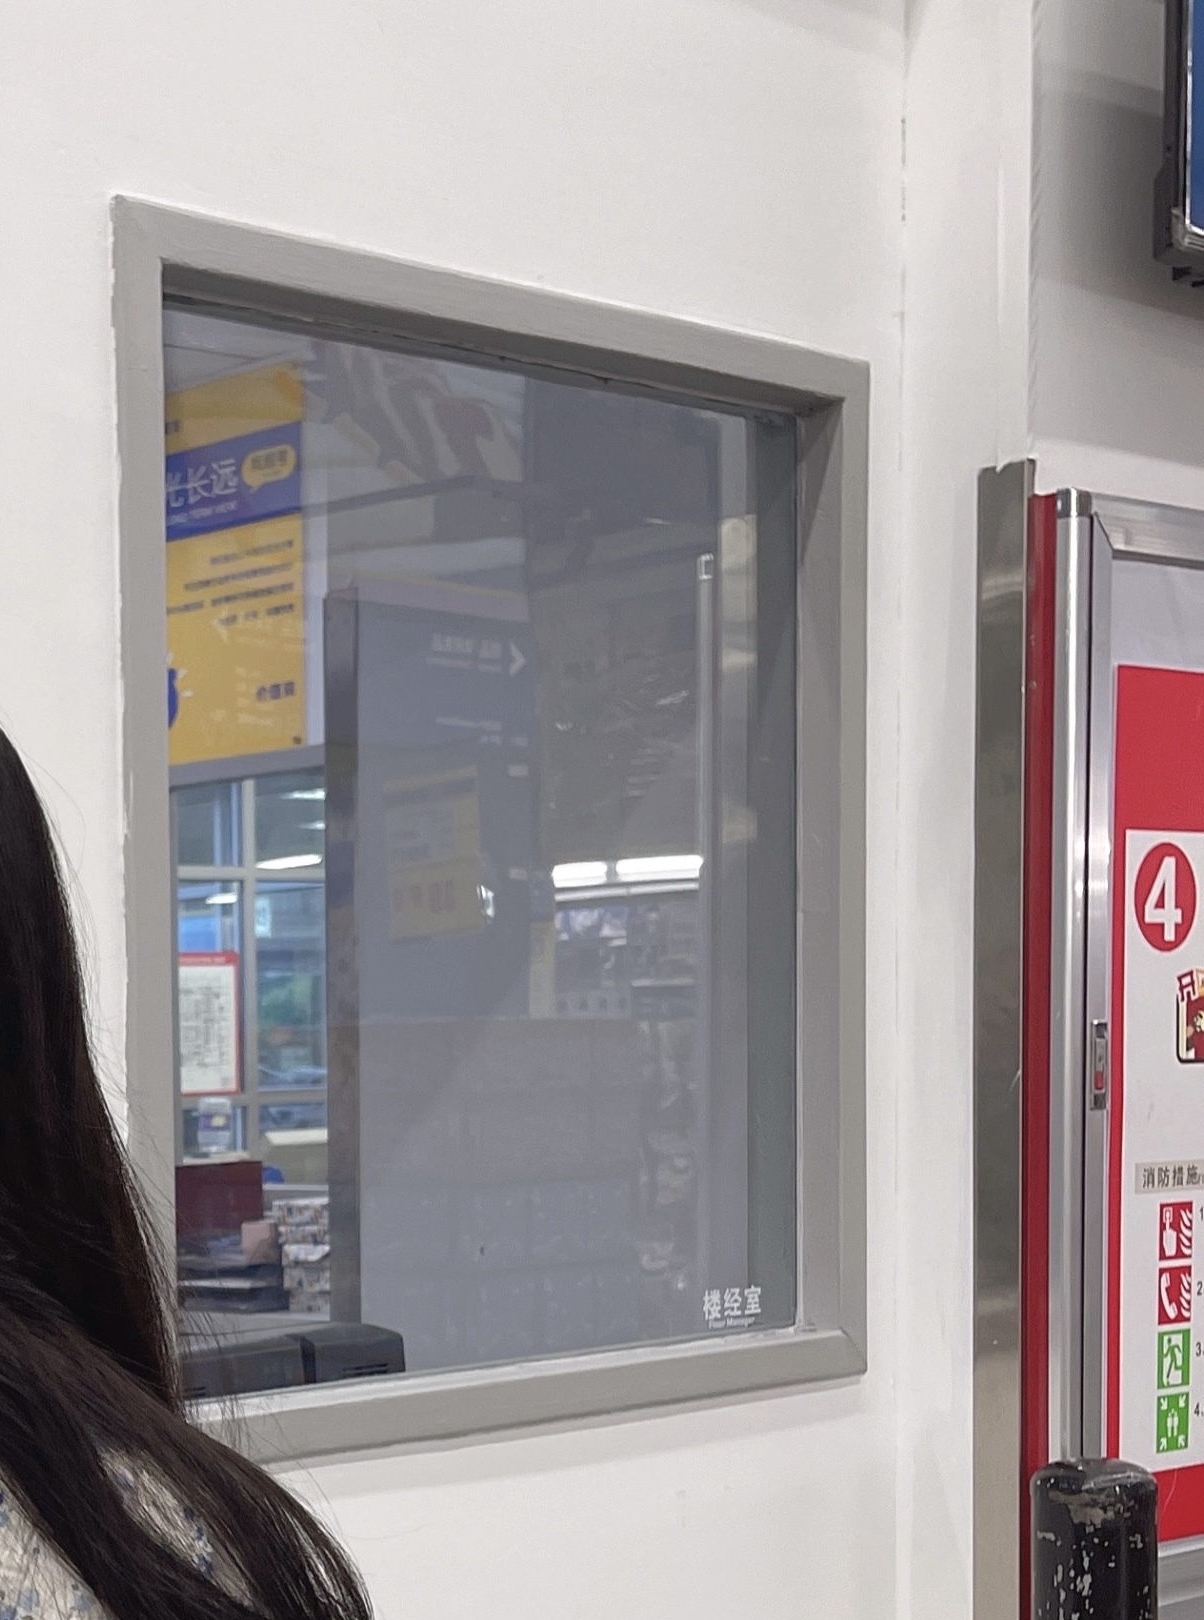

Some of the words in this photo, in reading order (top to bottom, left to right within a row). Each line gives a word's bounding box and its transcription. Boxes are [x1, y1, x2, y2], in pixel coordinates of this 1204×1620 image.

[1144, 856, 1183, 943] 4
[703, 1284, 762, 1321] 楼经室
